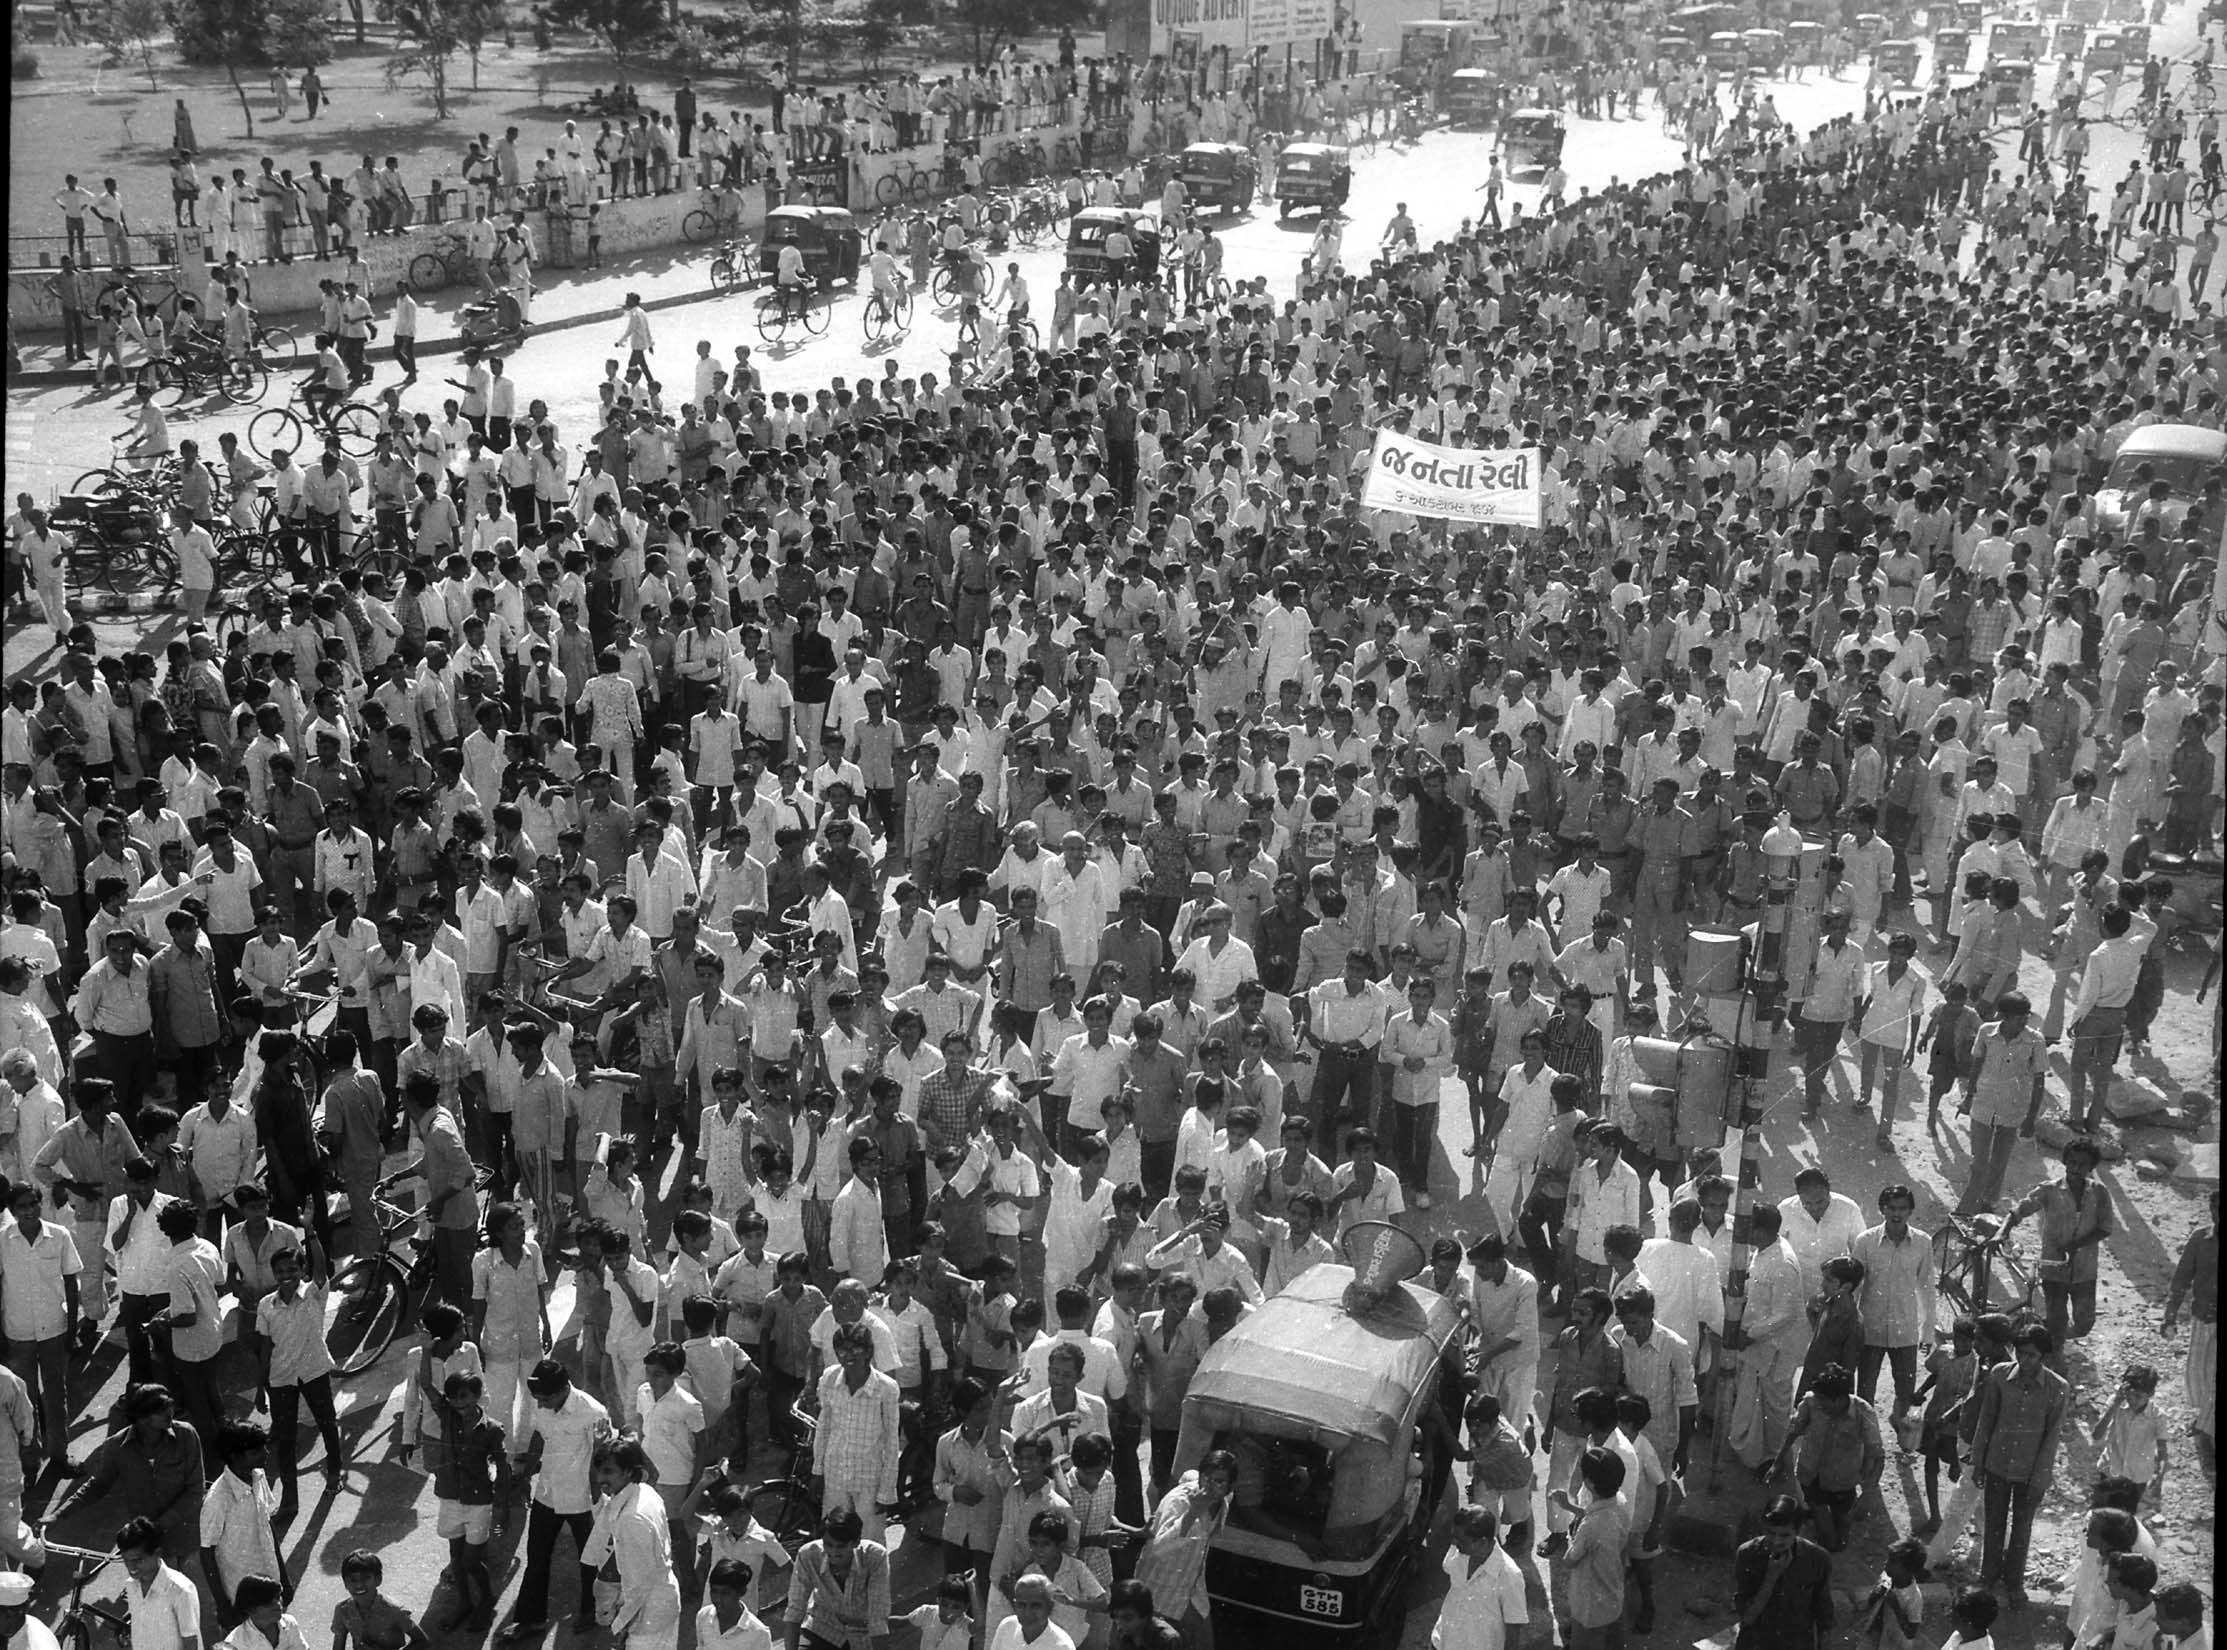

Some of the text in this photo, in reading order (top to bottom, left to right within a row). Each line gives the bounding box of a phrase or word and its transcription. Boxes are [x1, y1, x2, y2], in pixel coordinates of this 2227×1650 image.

[1381, 447, 1529, 490] જનતા રેલી
[1305, 1599, 1339, 1614] 585
